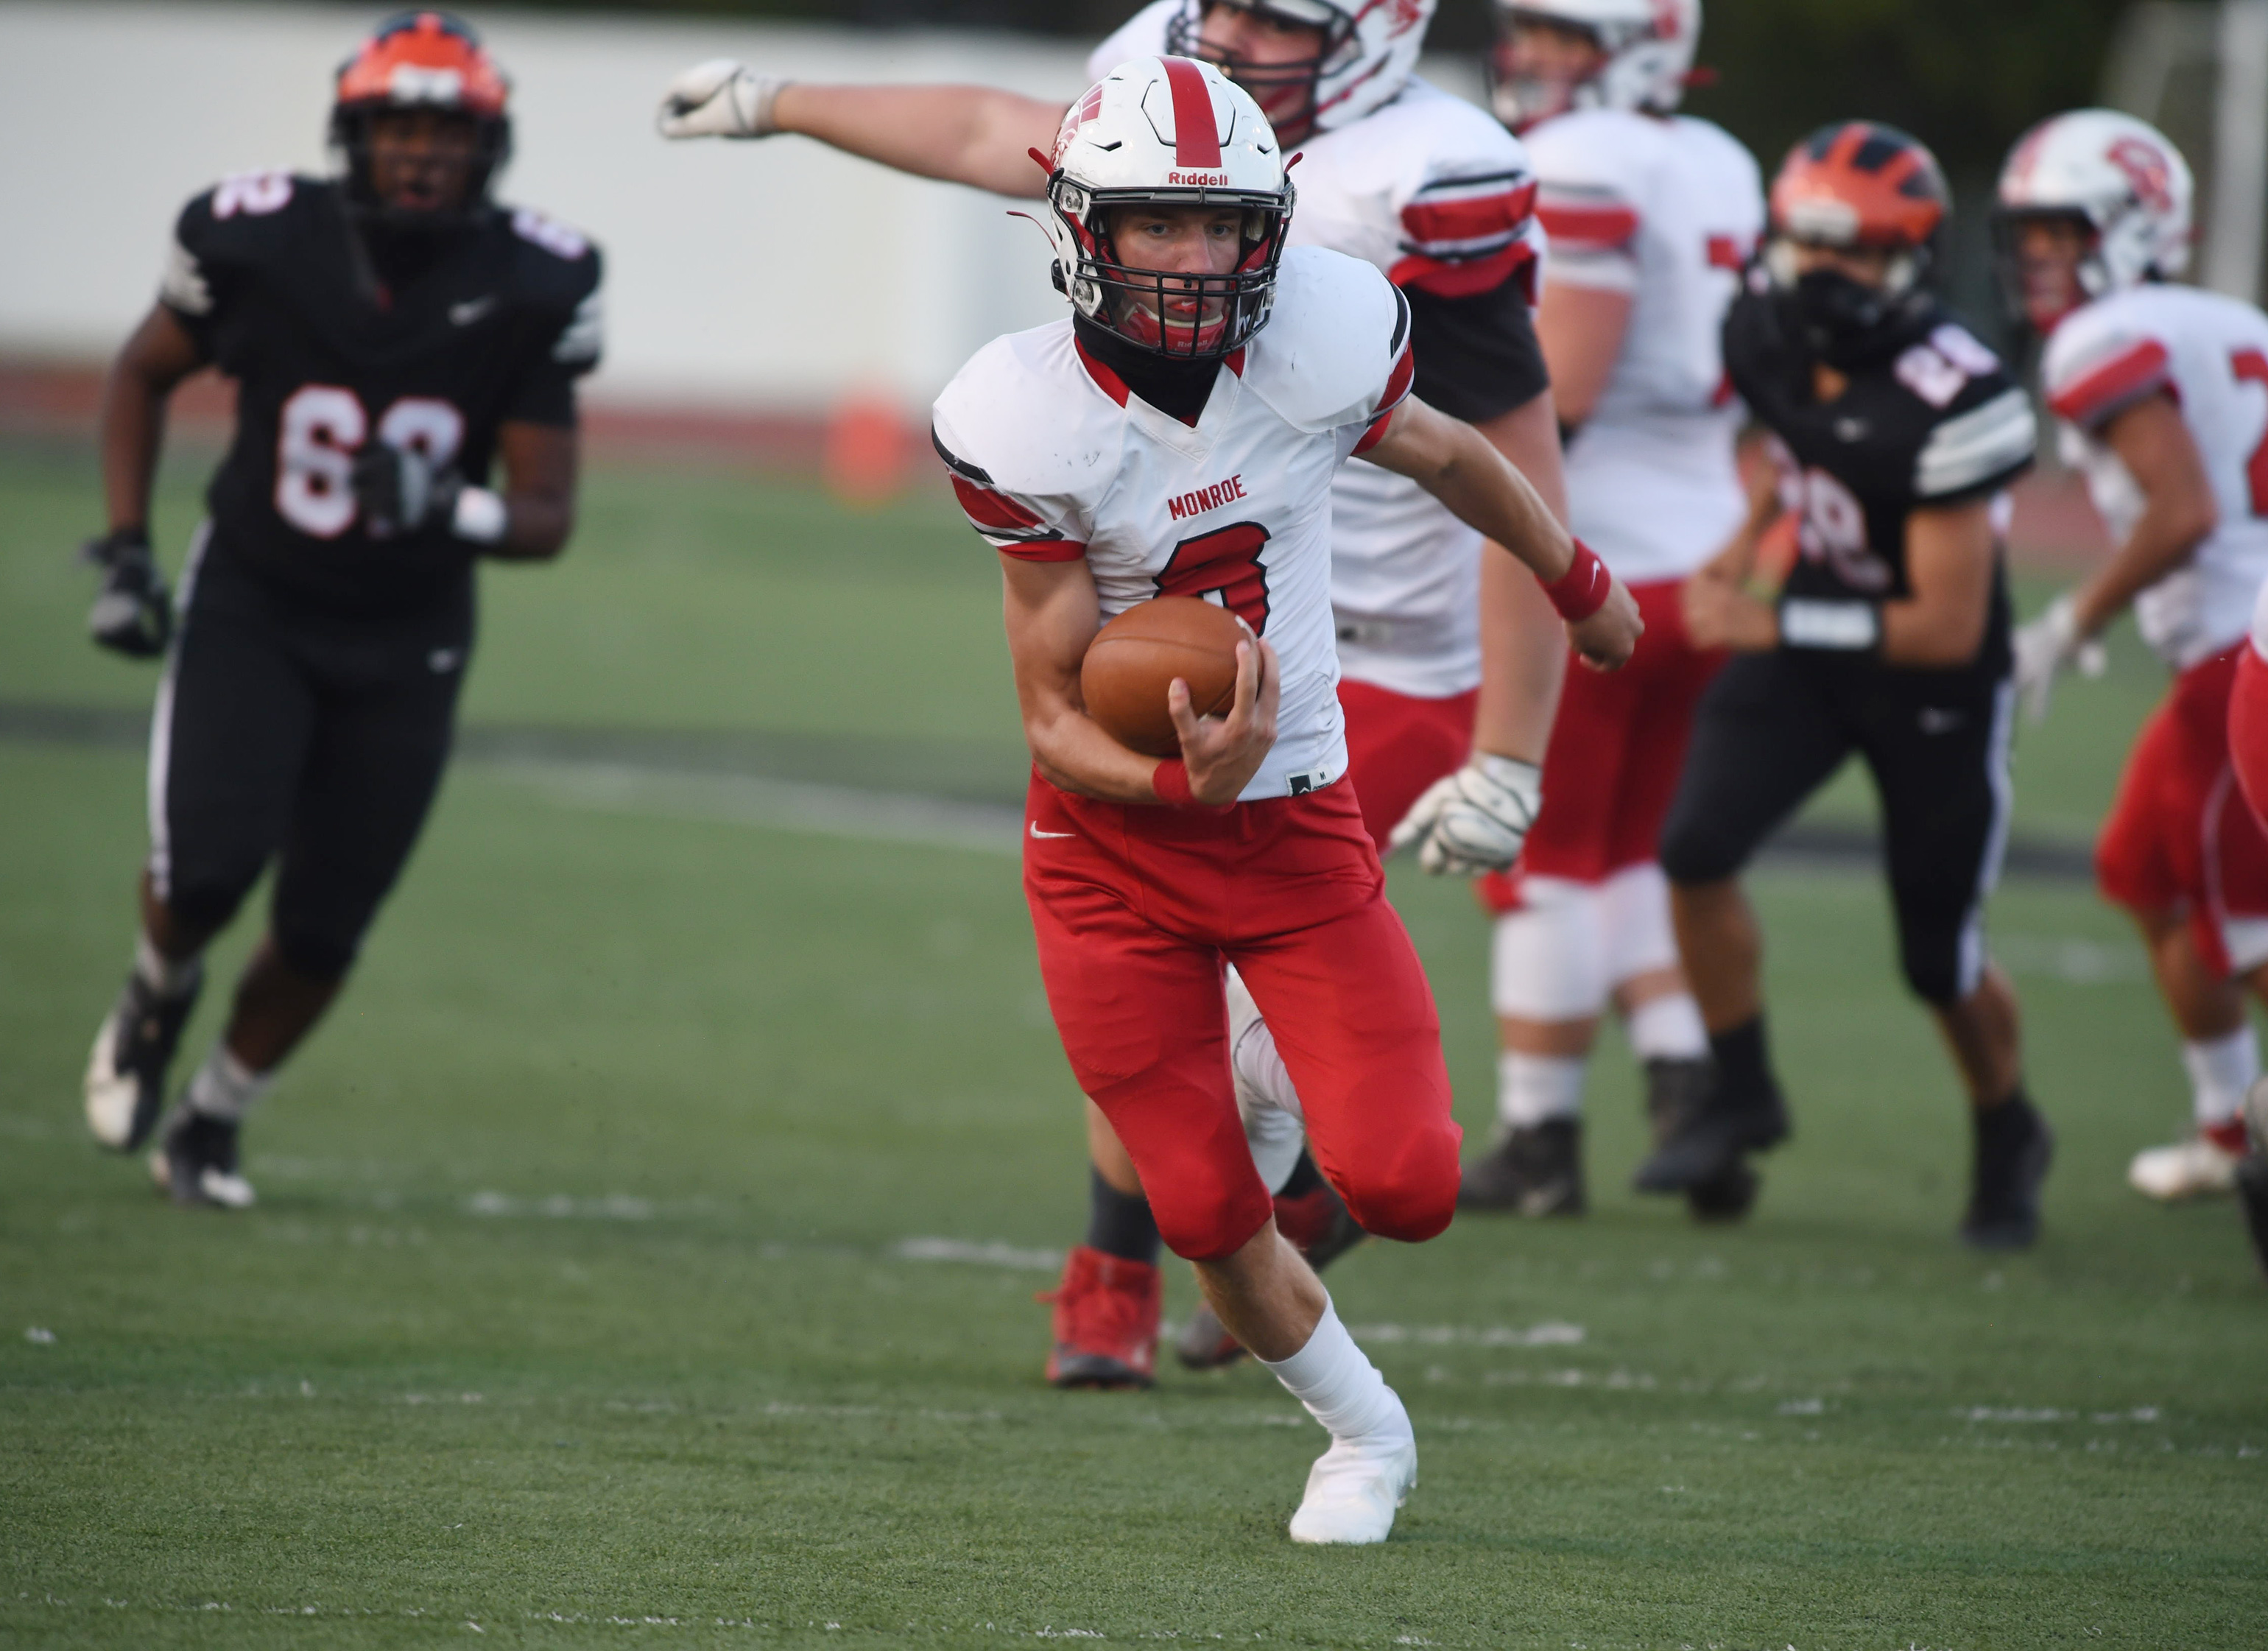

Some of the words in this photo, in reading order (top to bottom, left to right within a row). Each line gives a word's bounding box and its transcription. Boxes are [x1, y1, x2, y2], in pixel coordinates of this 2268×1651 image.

[1168, 172, 1228, 186] Riddell
[1177, 339, 1208, 348] Ridell
[1168, 474, 1247, 521] MONROE
[1319, 771, 1327, 781] M
